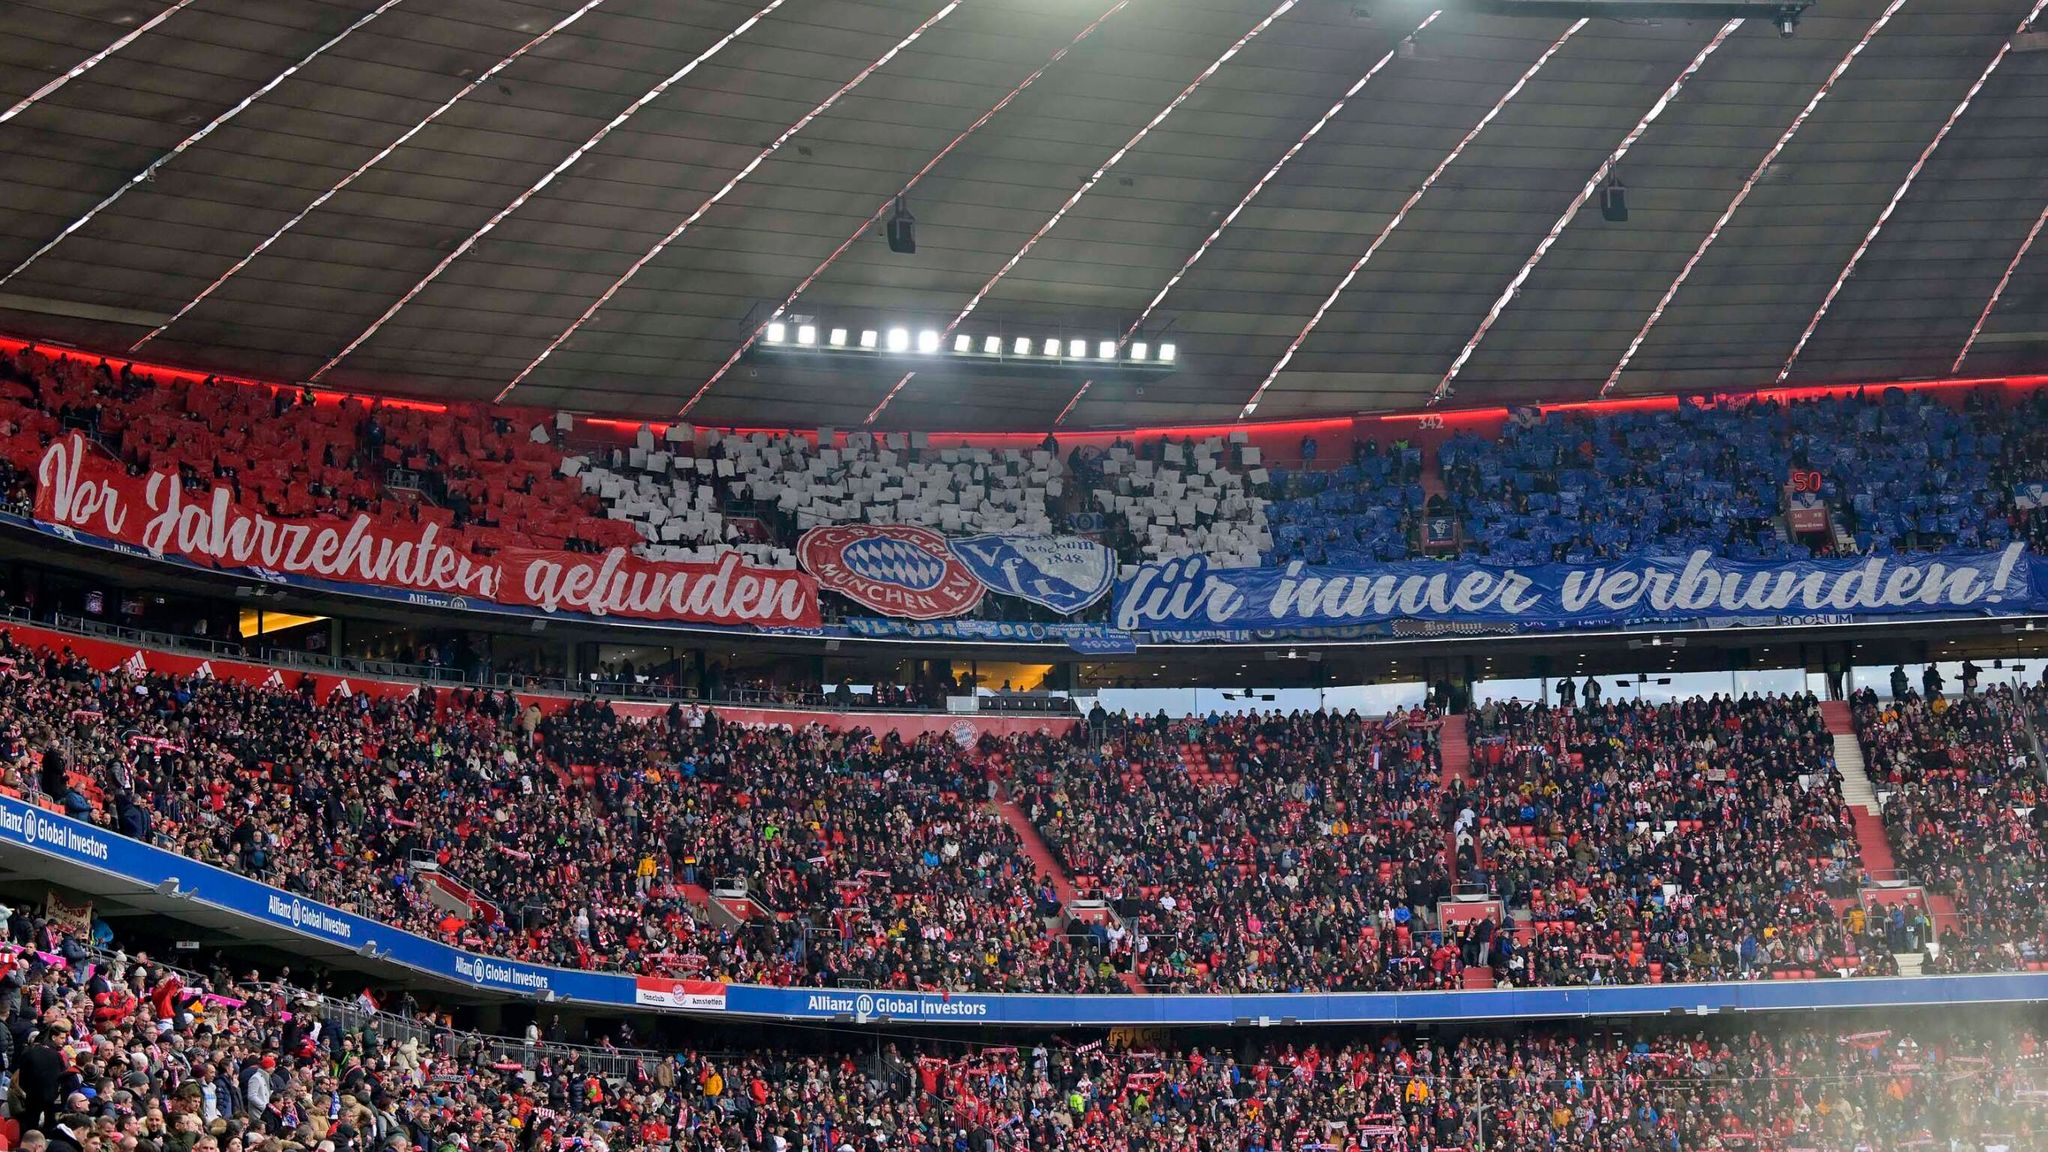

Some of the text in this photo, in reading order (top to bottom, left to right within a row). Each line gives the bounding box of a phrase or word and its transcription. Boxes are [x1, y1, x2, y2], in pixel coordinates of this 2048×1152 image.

[1418, 416, 1444, 430] 342
[39, 433, 806, 620] Vor Jahrzehnten gefunden
[1046, 553, 1085, 565] 1848
[818, 563, 938, 609] MÜNCHEN
[1117, 541, 2025, 630] für immer verbunden!
[1781, 614, 1851, 626] BOCHUM
[38, 818, 67, 847] Global
[68, 827, 108, 860] Investors
[268, 894, 351, 938] Allianz Global Investors
[455, 955, 548, 989] Allianz Global Investors
[808, 995, 987, 1015] Allianz Global Investors
